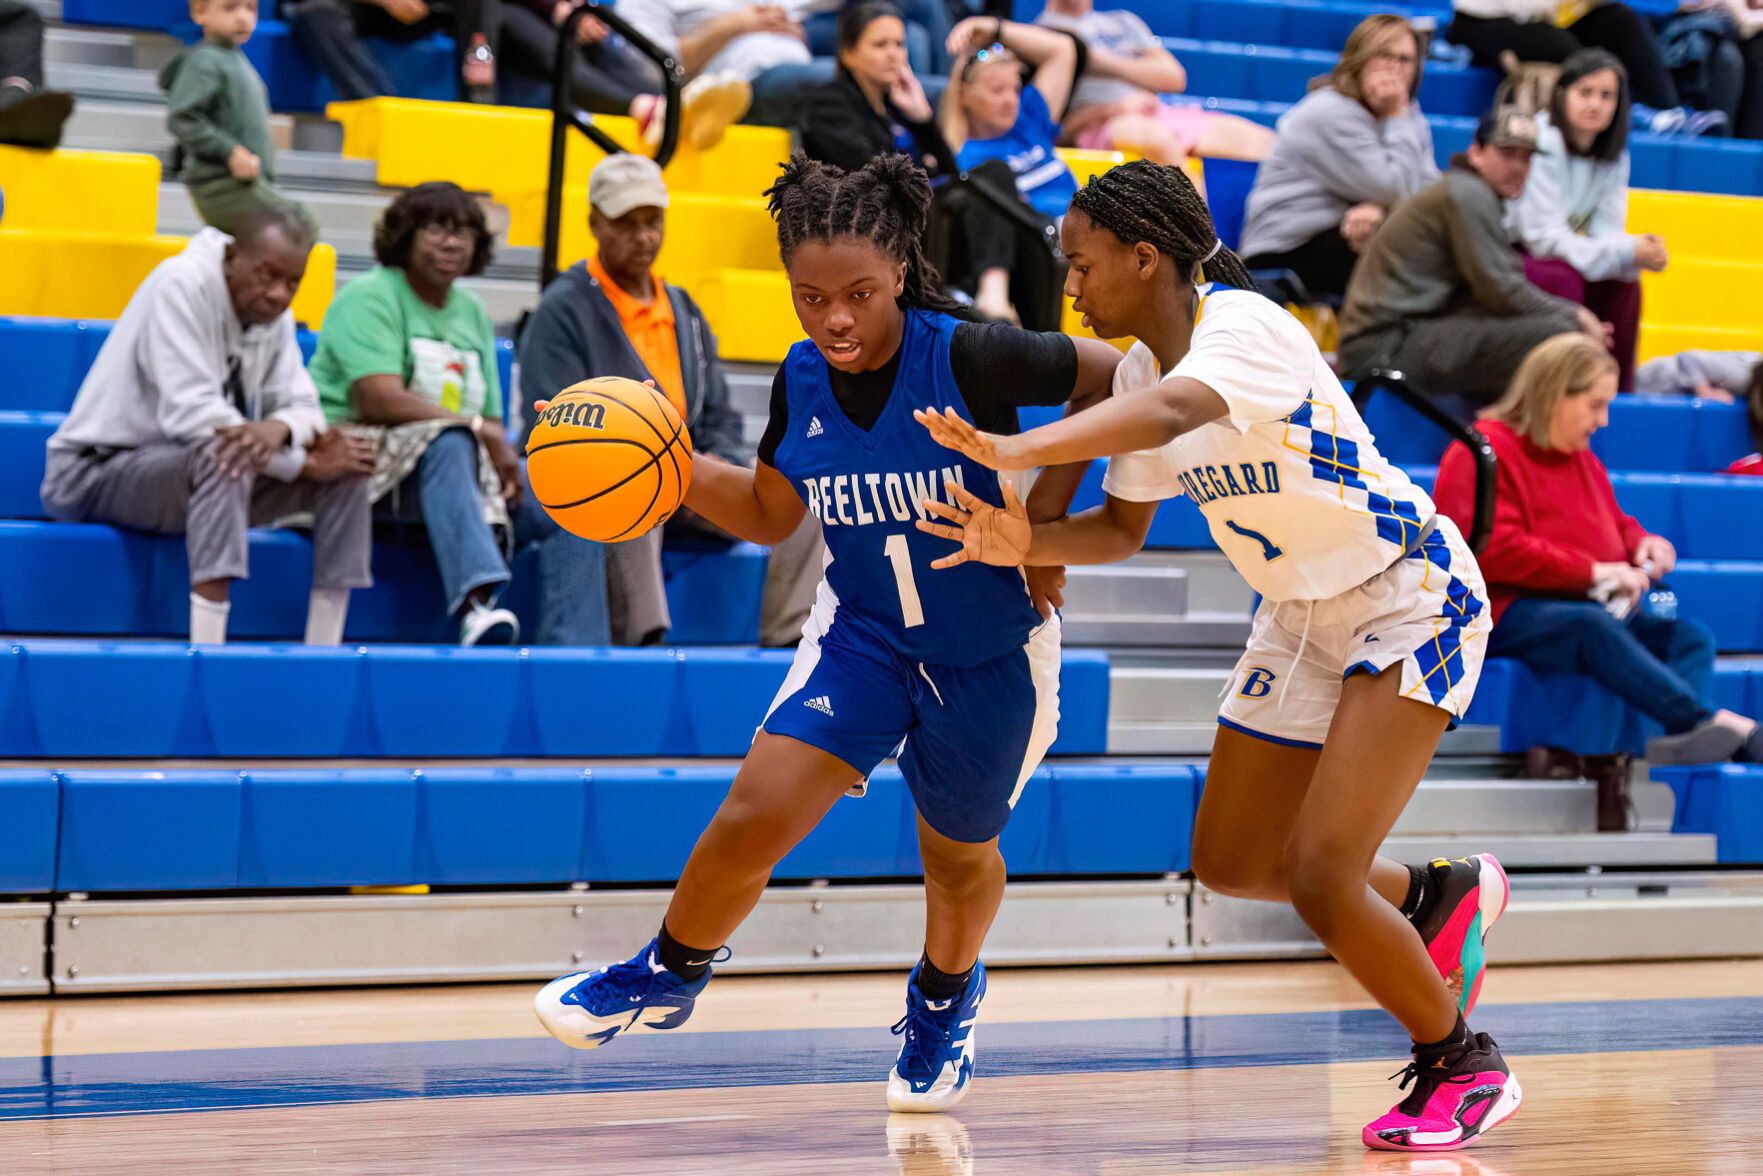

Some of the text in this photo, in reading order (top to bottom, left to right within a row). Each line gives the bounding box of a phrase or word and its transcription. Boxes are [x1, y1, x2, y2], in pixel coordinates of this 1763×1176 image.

[535, 402, 606, 430] Wilso
[802, 464, 967, 527] REELTOWN
[1224, 519, 1285, 563] 1
[883, 534, 925, 629] 1
[1236, 664, 1279, 700] B
[803, 699, 835, 717] adidas
